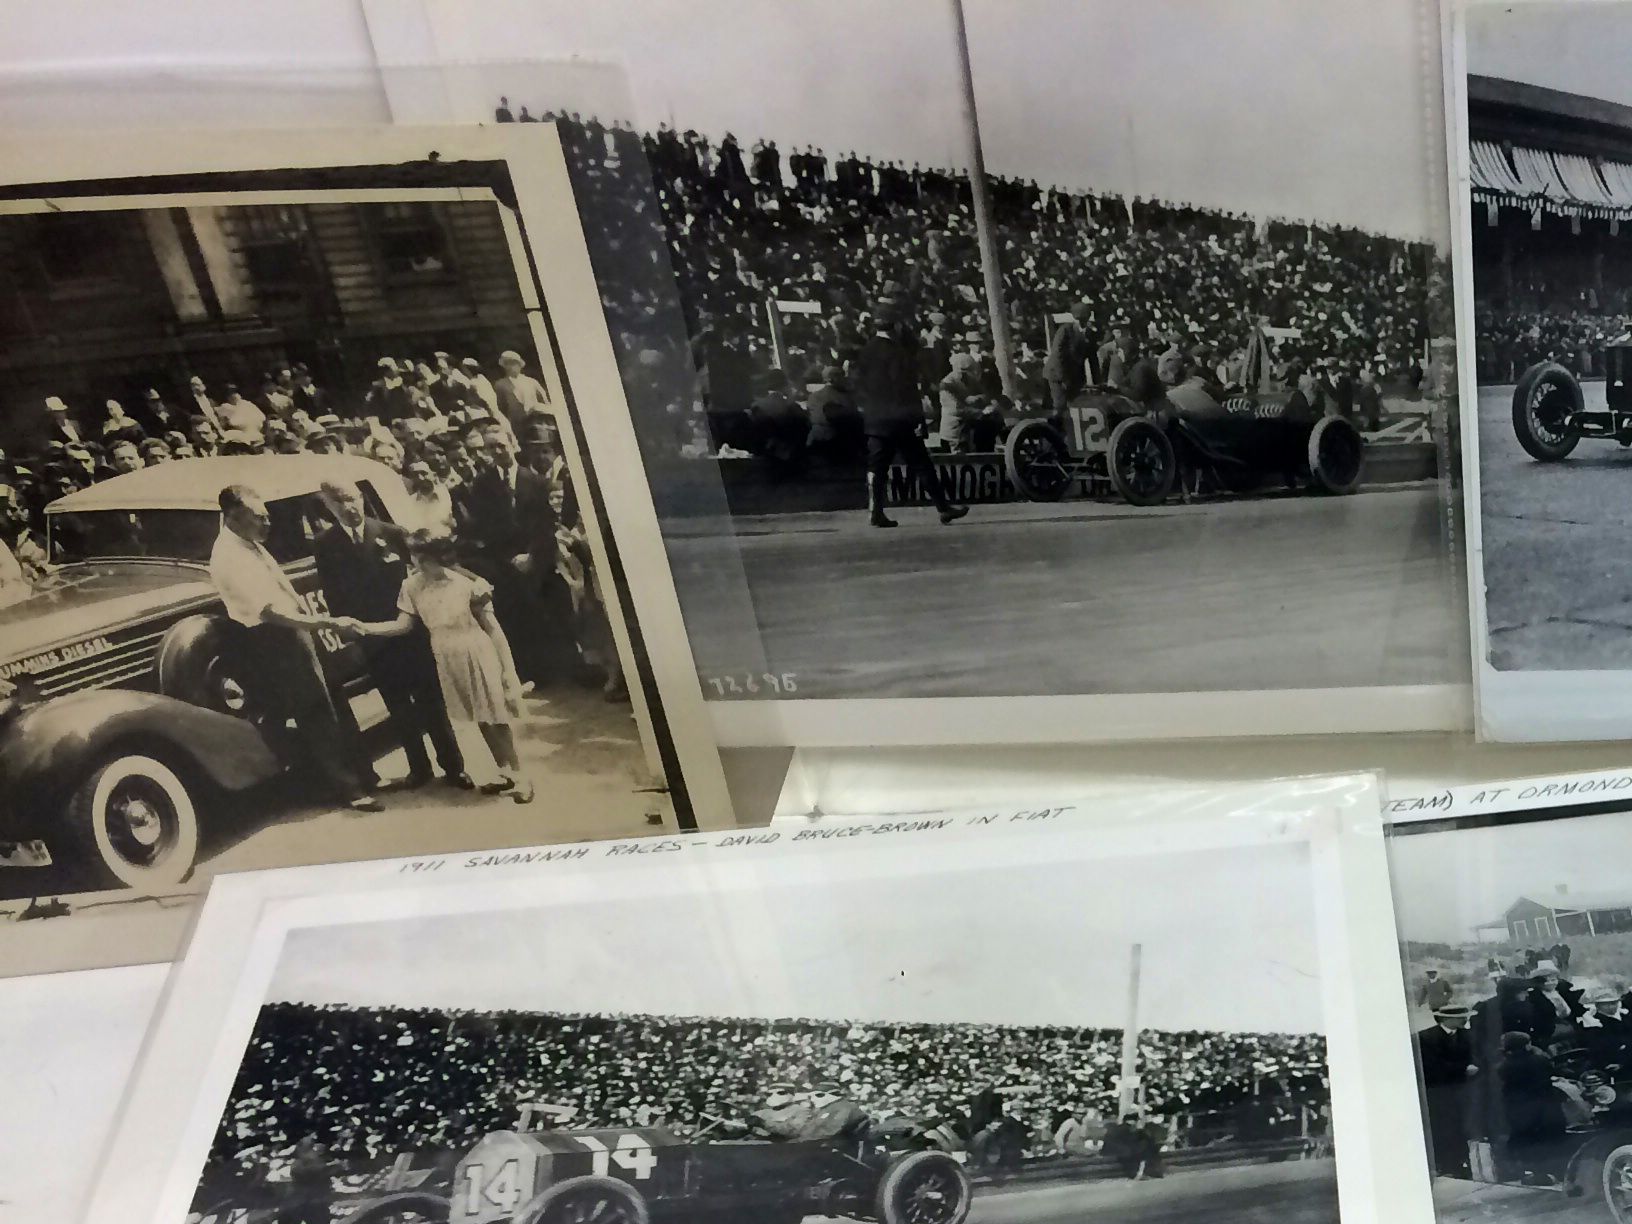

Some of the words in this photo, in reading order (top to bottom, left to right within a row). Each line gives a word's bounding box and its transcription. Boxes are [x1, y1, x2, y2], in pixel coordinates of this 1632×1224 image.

[1069, 406, 1107, 453] 12
[1470, 788, 1511, 804] AT
[1518, 775, 1632, 801] ORMOND
[400, 860, 446, 873] 1911
[464, 847, 590, 869] SAVANNAH
[605, 840, 683, 857] RACES
[715, 832, 782, 848] DAVID
[967, 813, 1000, 826] IN
[1009, 806, 1077, 823] FIAT
[573, 1133, 658, 1180] 14
[465, 1158, 523, 1217] 14
